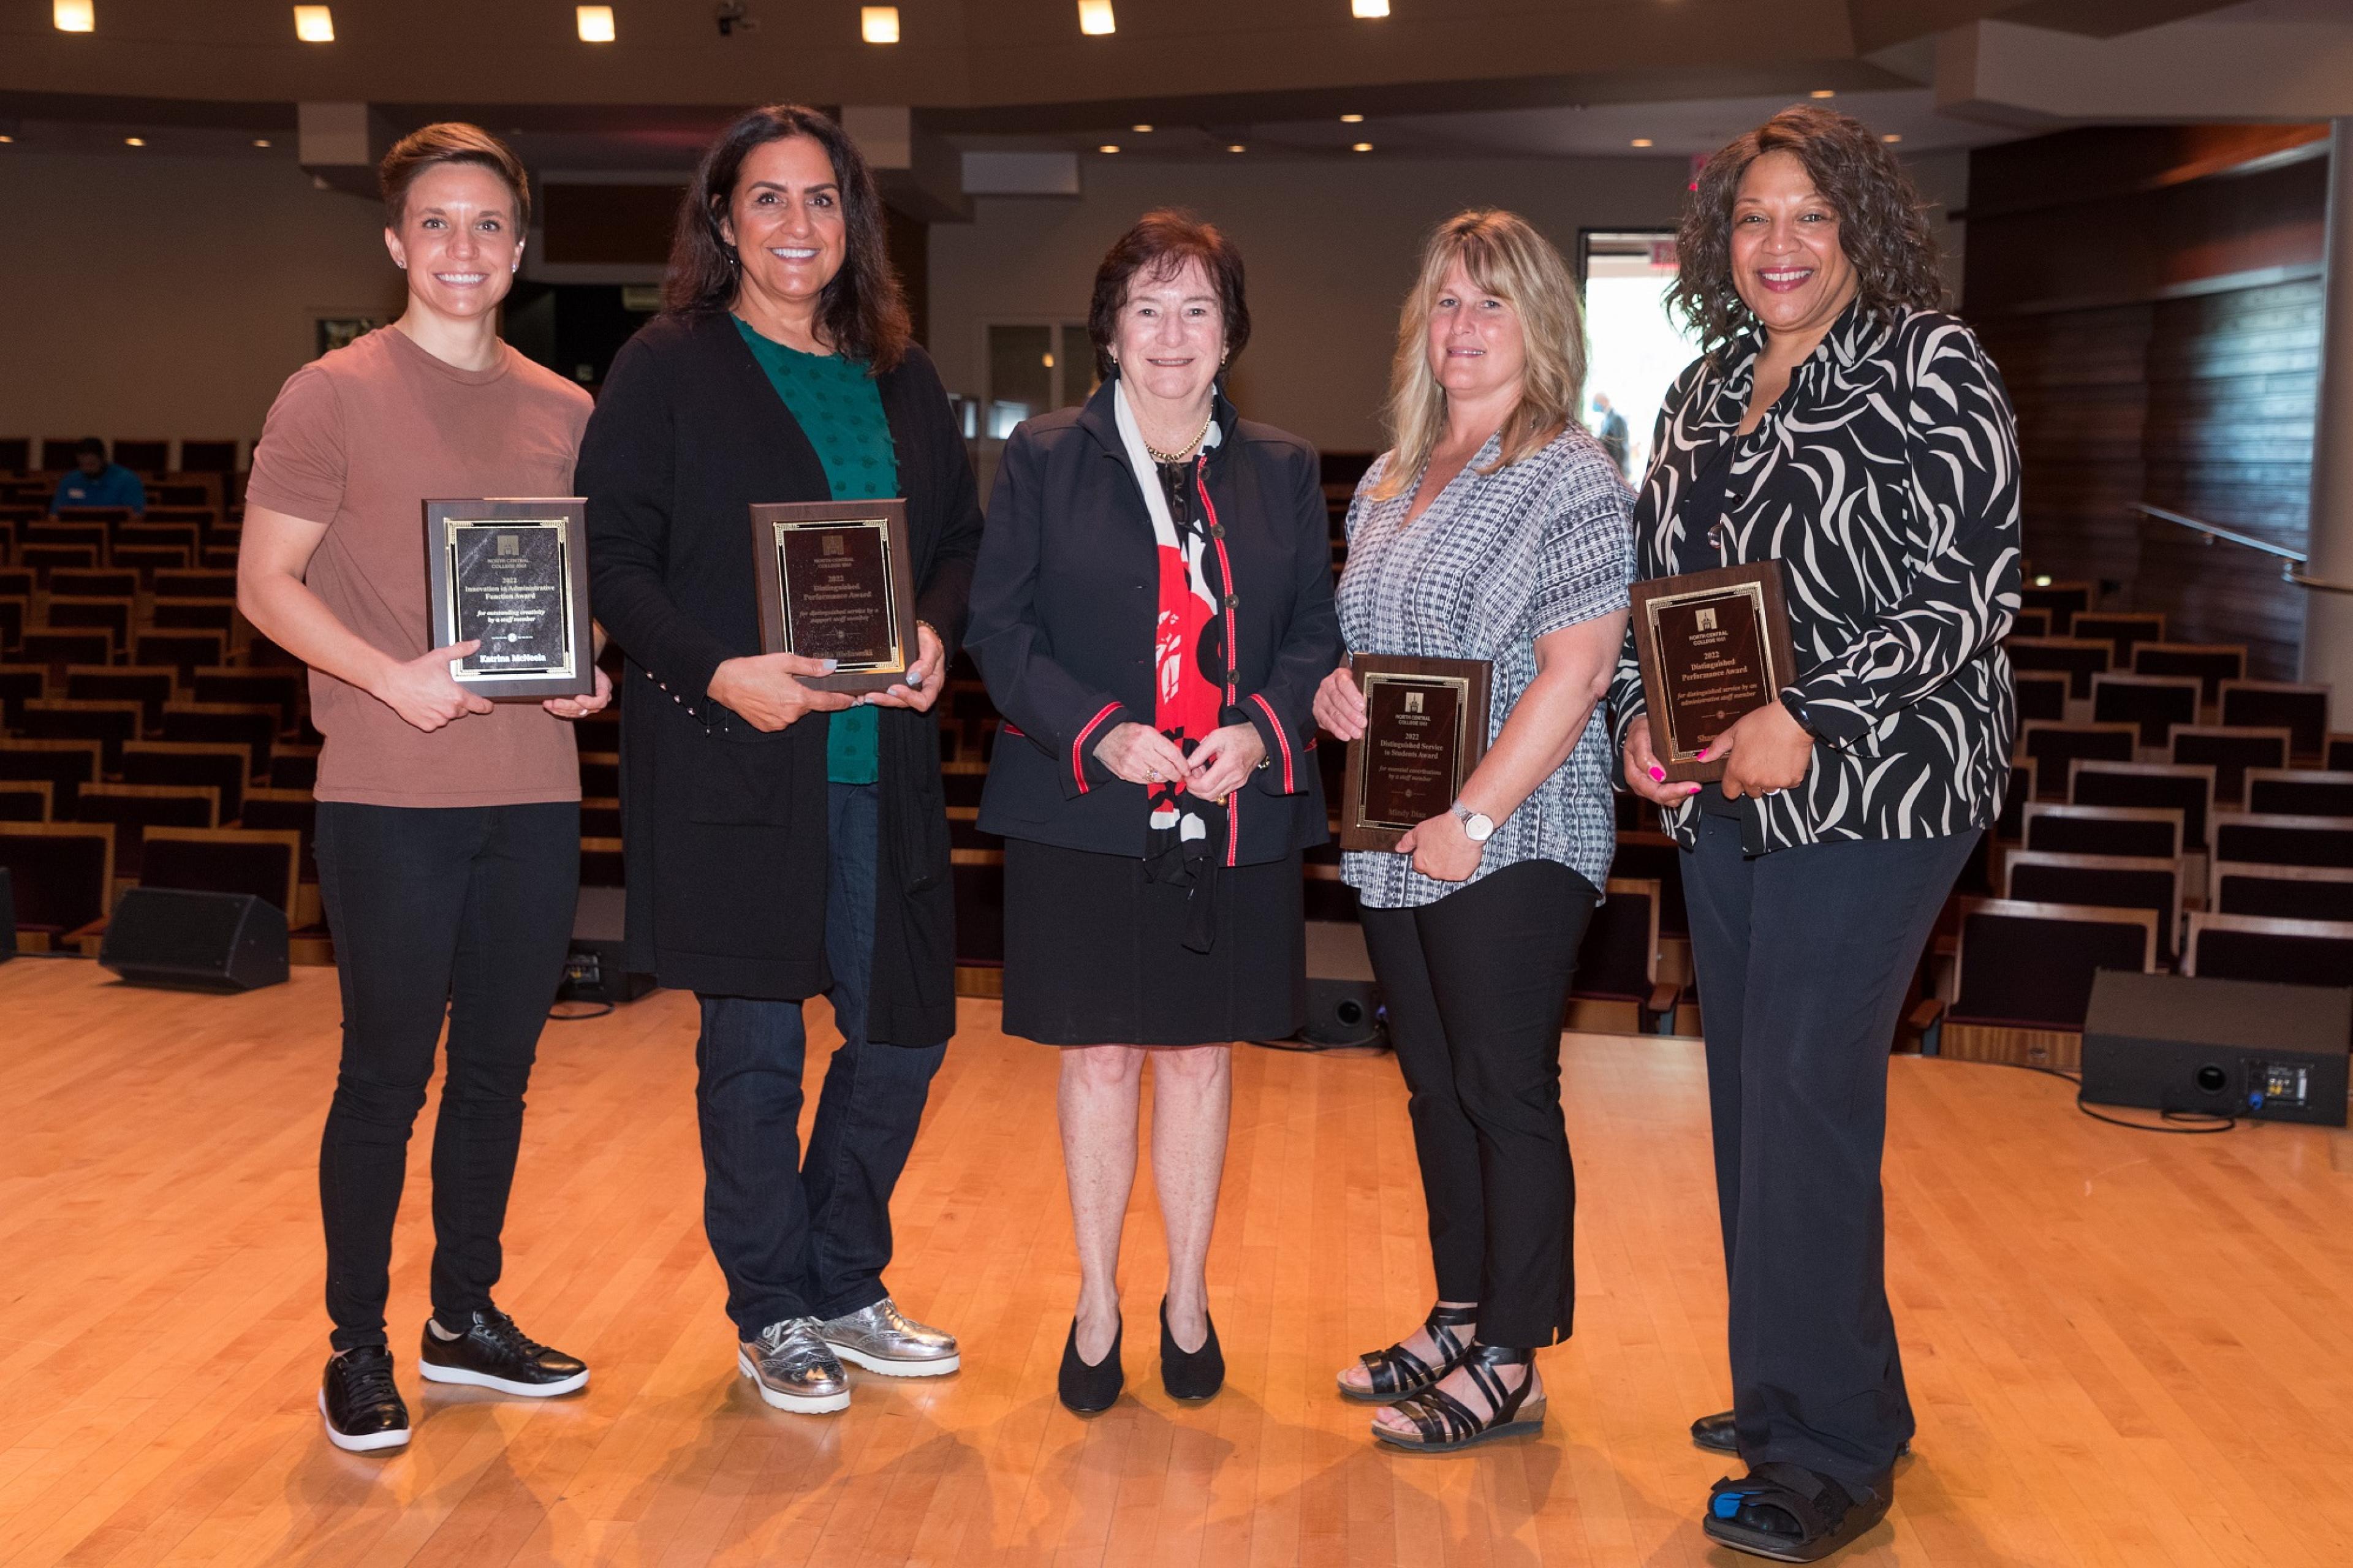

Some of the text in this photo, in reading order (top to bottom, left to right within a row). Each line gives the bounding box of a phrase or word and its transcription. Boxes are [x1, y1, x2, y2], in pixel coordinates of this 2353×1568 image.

[814, 583, 861, 593] Distinguished
[1705, 630, 1729, 638] CENTRAL
[480, 654, 511, 662] Katrina
[1703, 651, 1720, 660] 2022
[1691, 657, 1736, 671] Distinguished
[1682, 665, 1748, 682] Performance Award
[1686, 687, 1722, 697] distinguished
[1720, 692, 1733, 702] staff
[1381, 740, 1443, 751] Distinguished Service
[1391, 749, 1417, 758] Students
